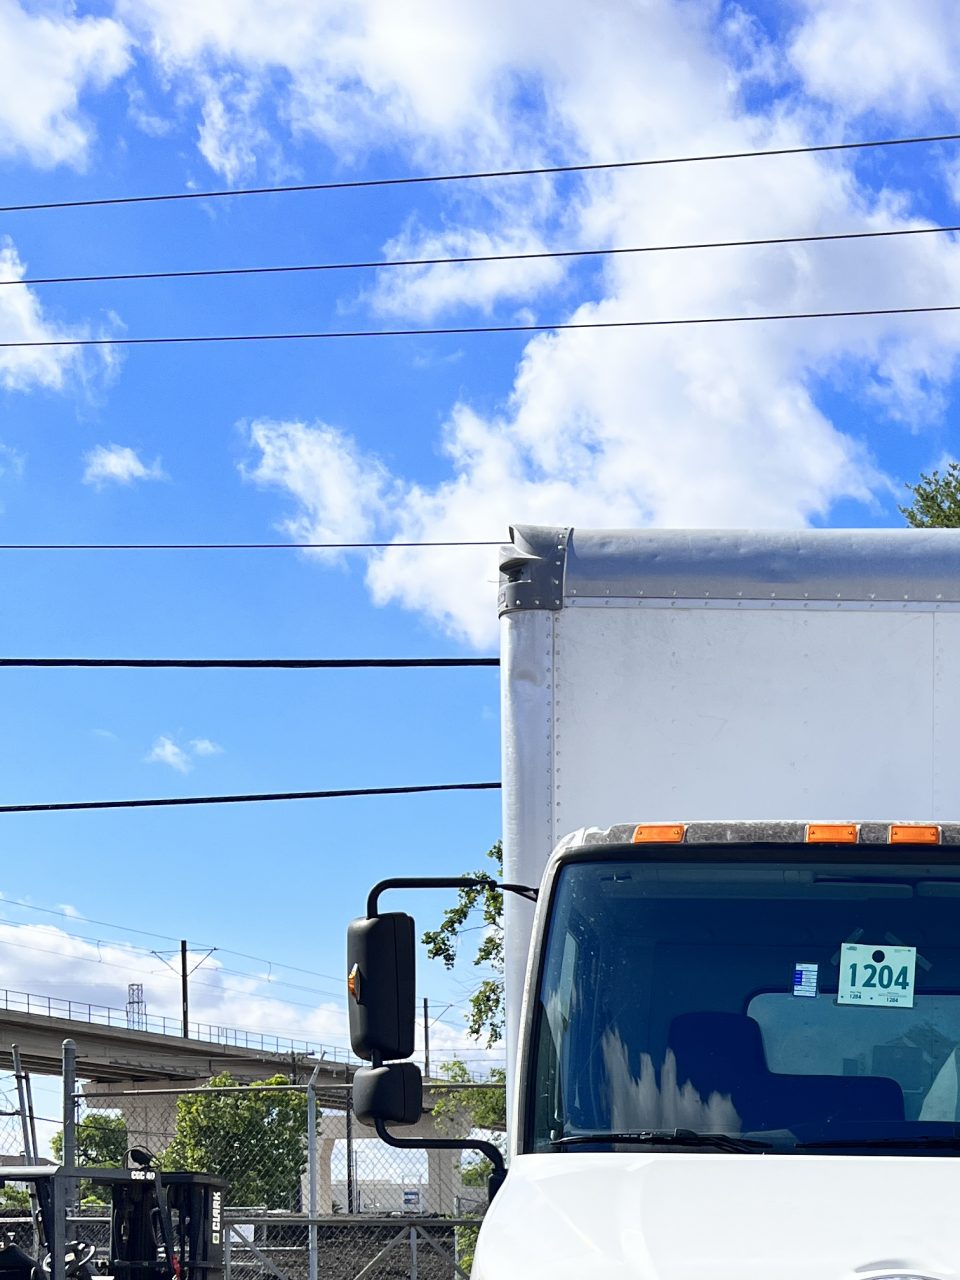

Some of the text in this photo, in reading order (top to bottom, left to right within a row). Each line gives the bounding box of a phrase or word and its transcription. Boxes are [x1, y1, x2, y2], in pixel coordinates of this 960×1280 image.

[849, 963, 909, 990] 1204
[146, 1172, 155, 1180] 40
[212, 1191, 221, 1231] CLARK
